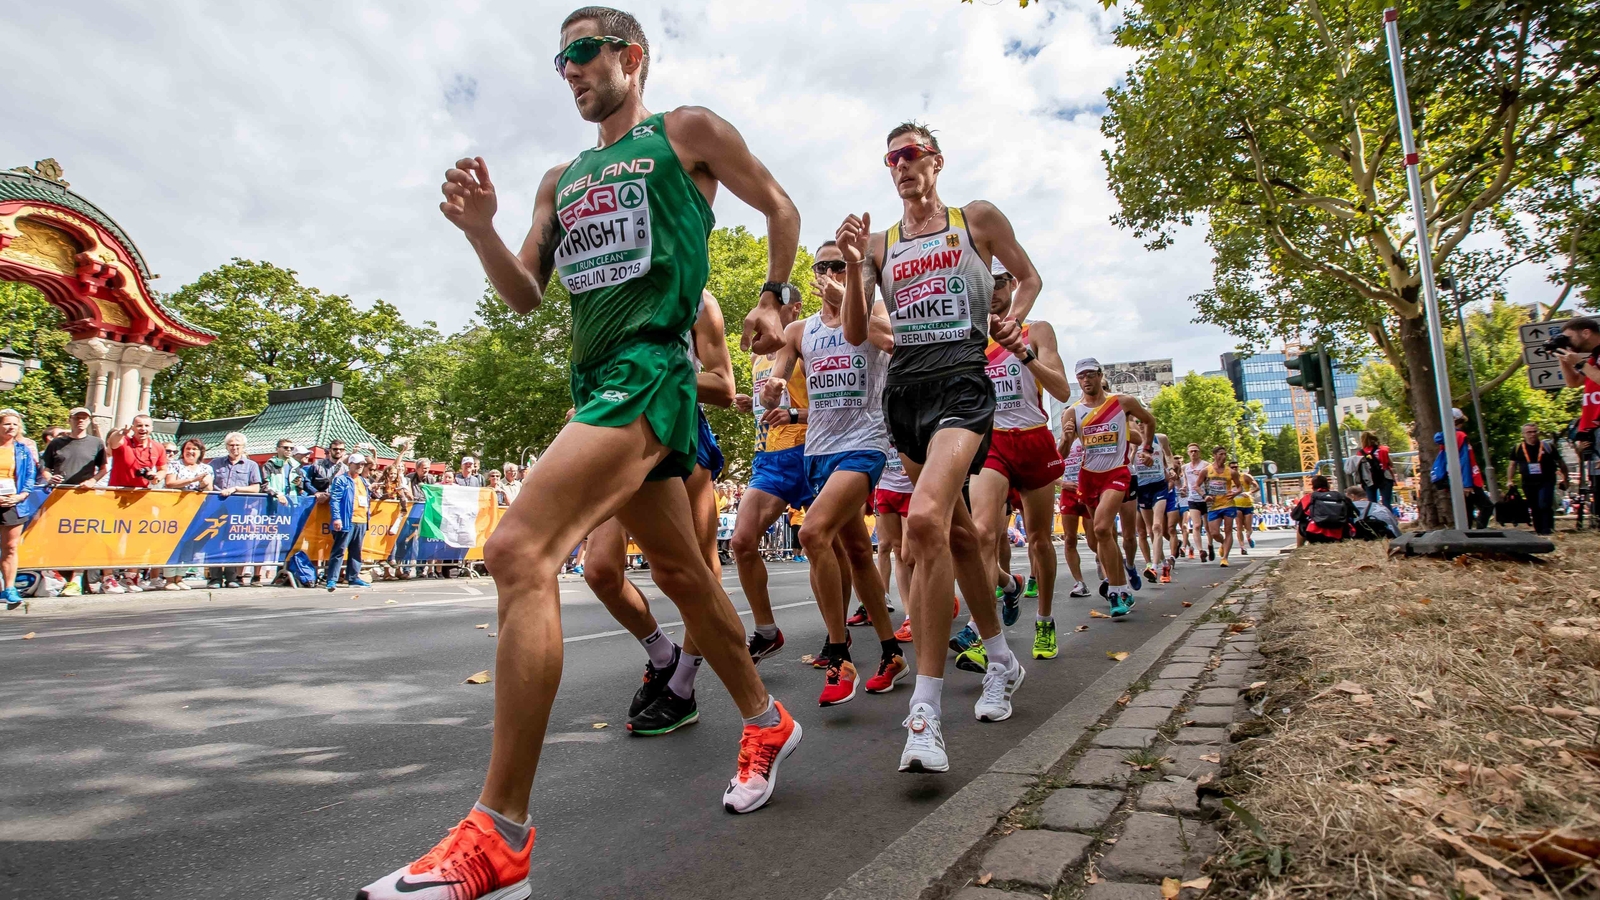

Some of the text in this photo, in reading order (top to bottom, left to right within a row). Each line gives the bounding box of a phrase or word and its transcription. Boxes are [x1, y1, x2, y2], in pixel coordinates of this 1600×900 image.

[632, 125, 655, 137] CX
[557, 158, 655, 206] IRELAND
[557, 217, 629, 258] WRIGHT
[922, 240, 941, 249] DKB
[579, 259, 595, 270] RUN
[893, 249, 963, 282] GERMANY
[567, 262, 641, 291] BERLIN 2018
[897, 279, 945, 306] SPAR
[896, 299, 954, 320] LINKE
[812, 333, 846, 352] ITAL
[901, 329, 965, 344] BERLIN 2018
[809, 372, 856, 390] RUBINO
[996, 379, 1013, 392] TIN
[814, 398, 863, 409] BERLIN 2018
[1003, 400, 1021, 409] 2018
[58, 518, 178, 534] BERLIN 2018
[230, 514, 292, 525] EUROPEAN
[228, 533, 290, 541] CHAMPIONSHIPS
[229, 525, 279, 534] ATHLETICS
